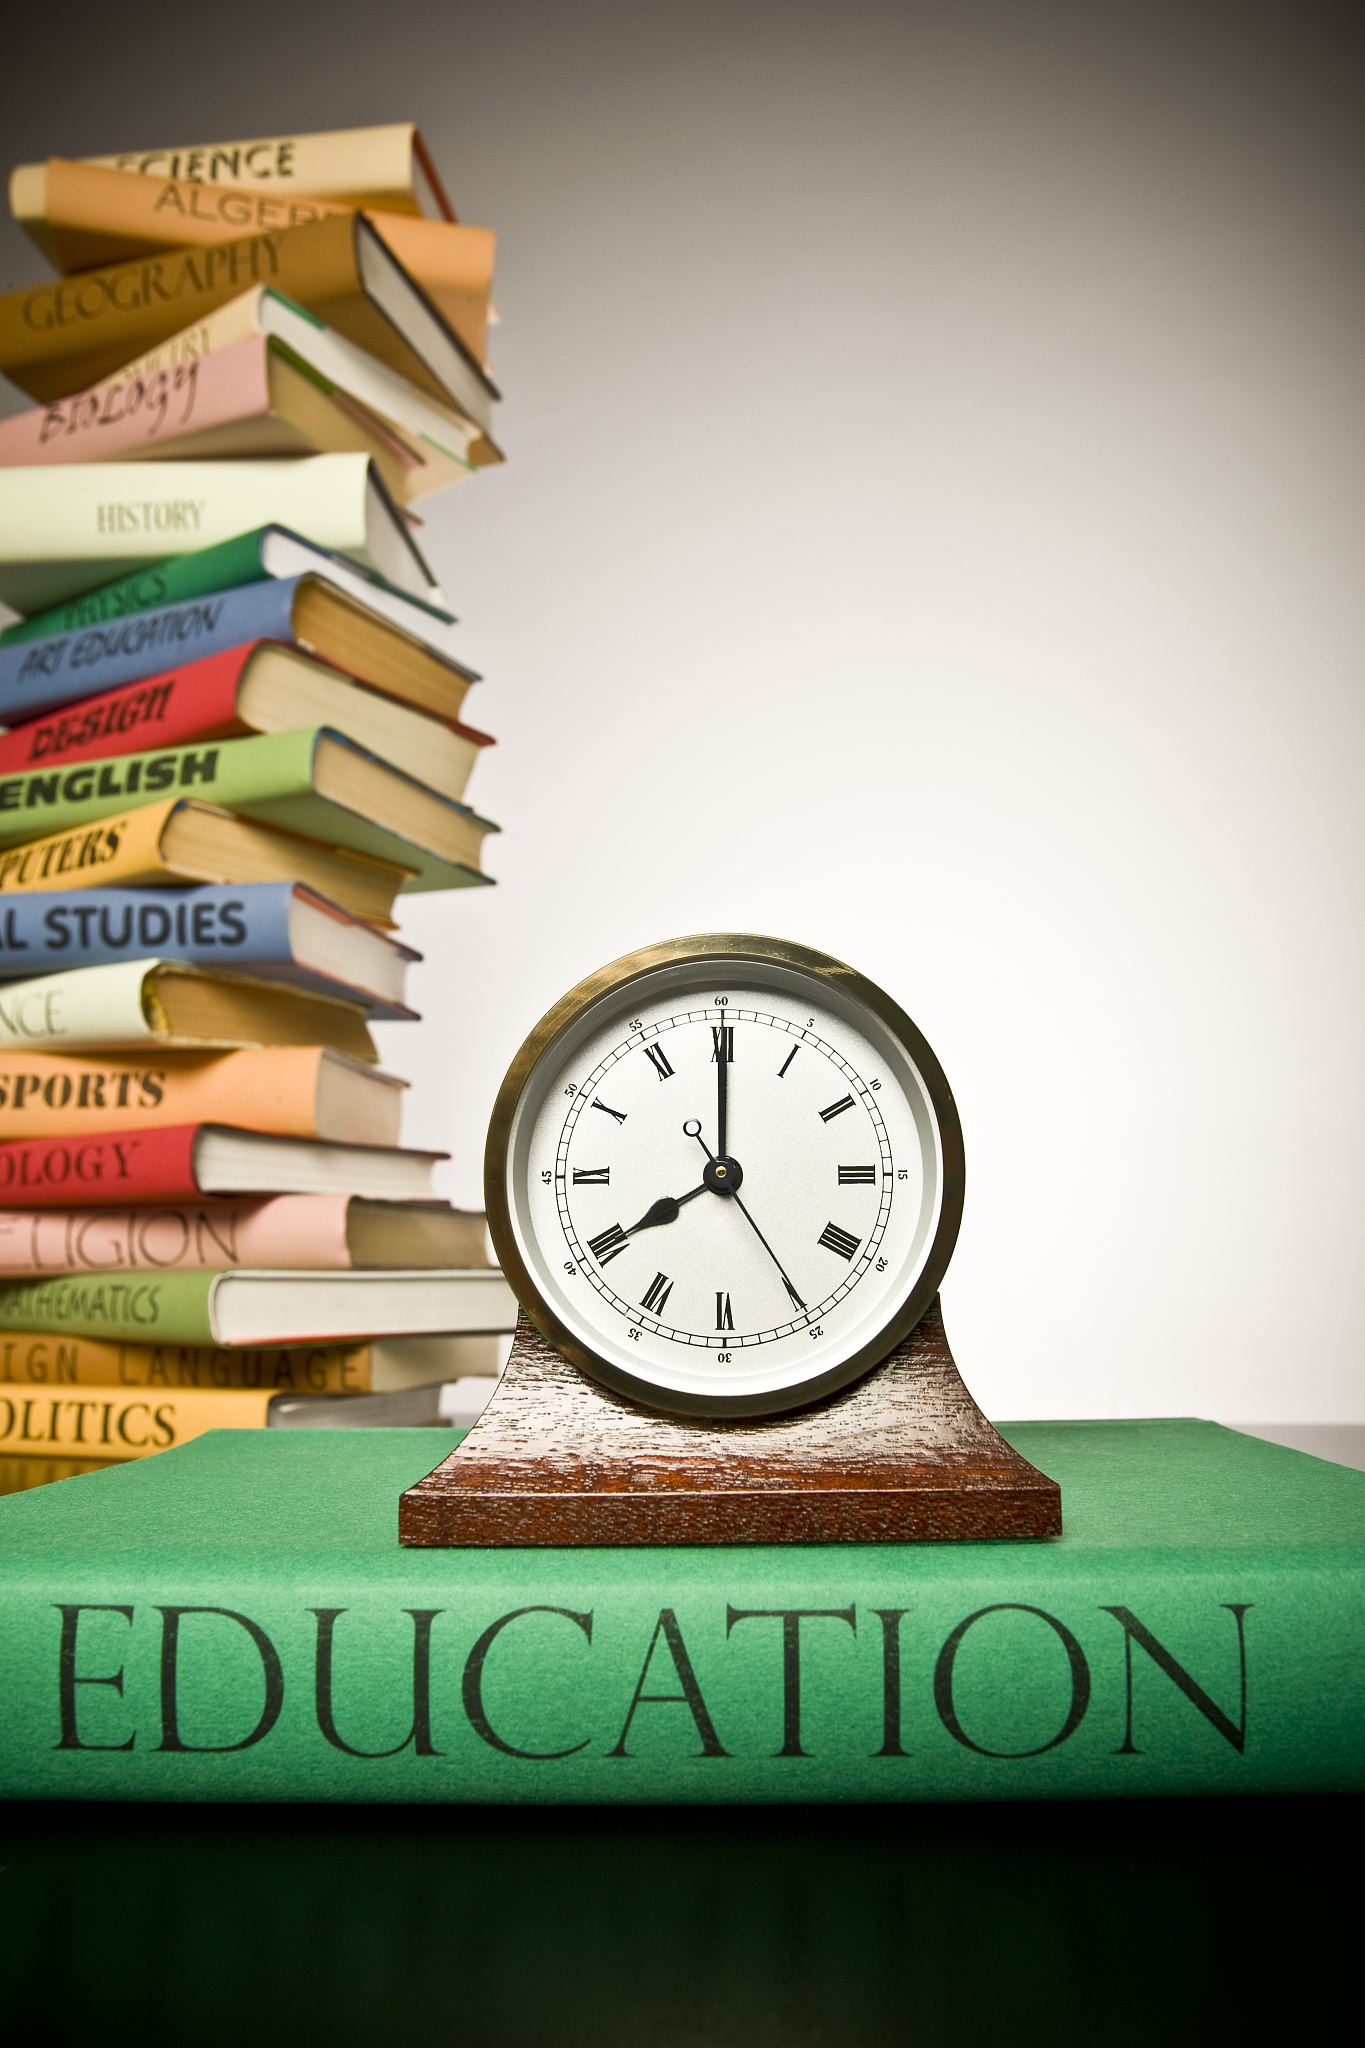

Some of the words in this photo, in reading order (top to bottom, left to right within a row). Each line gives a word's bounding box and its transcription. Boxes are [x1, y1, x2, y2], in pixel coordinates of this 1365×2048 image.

[21, 231, 290, 333] GEOGRAPHY
[38, 360, 199, 444] BIOLOGY
[97, 499, 206, 534] HISTORY
[16, 637, 68, 685] ART
[68, 598, 226, 670] EDUCATION
[0, 750, 219, 812] ENGLISH
[0, 908, 28, 950] L
[44, 901, 248, 950] STUDIES
[714, 996, 728, 1005] 60
[628, 1018, 643, 1032] 55
[806, 1018, 815, 1028] 5
[710, 1026, 735, 1063] XII
[642, 1042, 676, 1082] XI
[776, 1043, 801, 1078] I
[564, 1083, 578, 1098] 50
[869, 1078, 882, 1091] 10
[590, 1096, 628, 1126] X
[818, 1093, 857, 1124] II
[541, 1170, 552, 1185] 45
[573, 1166, 610, 1186] IX
[838, 1164, 876, 1186] III
[897, 1169, 908, 1180] 15
[586, 1222, 631, 1268] VIII
[563, 1261, 577, 1276] 40
[875, 1256, 889, 1273] 20
[0, 1284, 162, 1324] ATHEMATICS
[639, 1271, 674, 1317] VII
[715, 1291, 736, 1331] VI
[627, 1328, 643, 1342] 35
[809, 1325, 824, 1340] 25
[118, 1344, 364, 1393] LANGUAGE
[717, 1353, 732, 1363] 30
[50, 1602, 1256, 1759] EDUCATION
